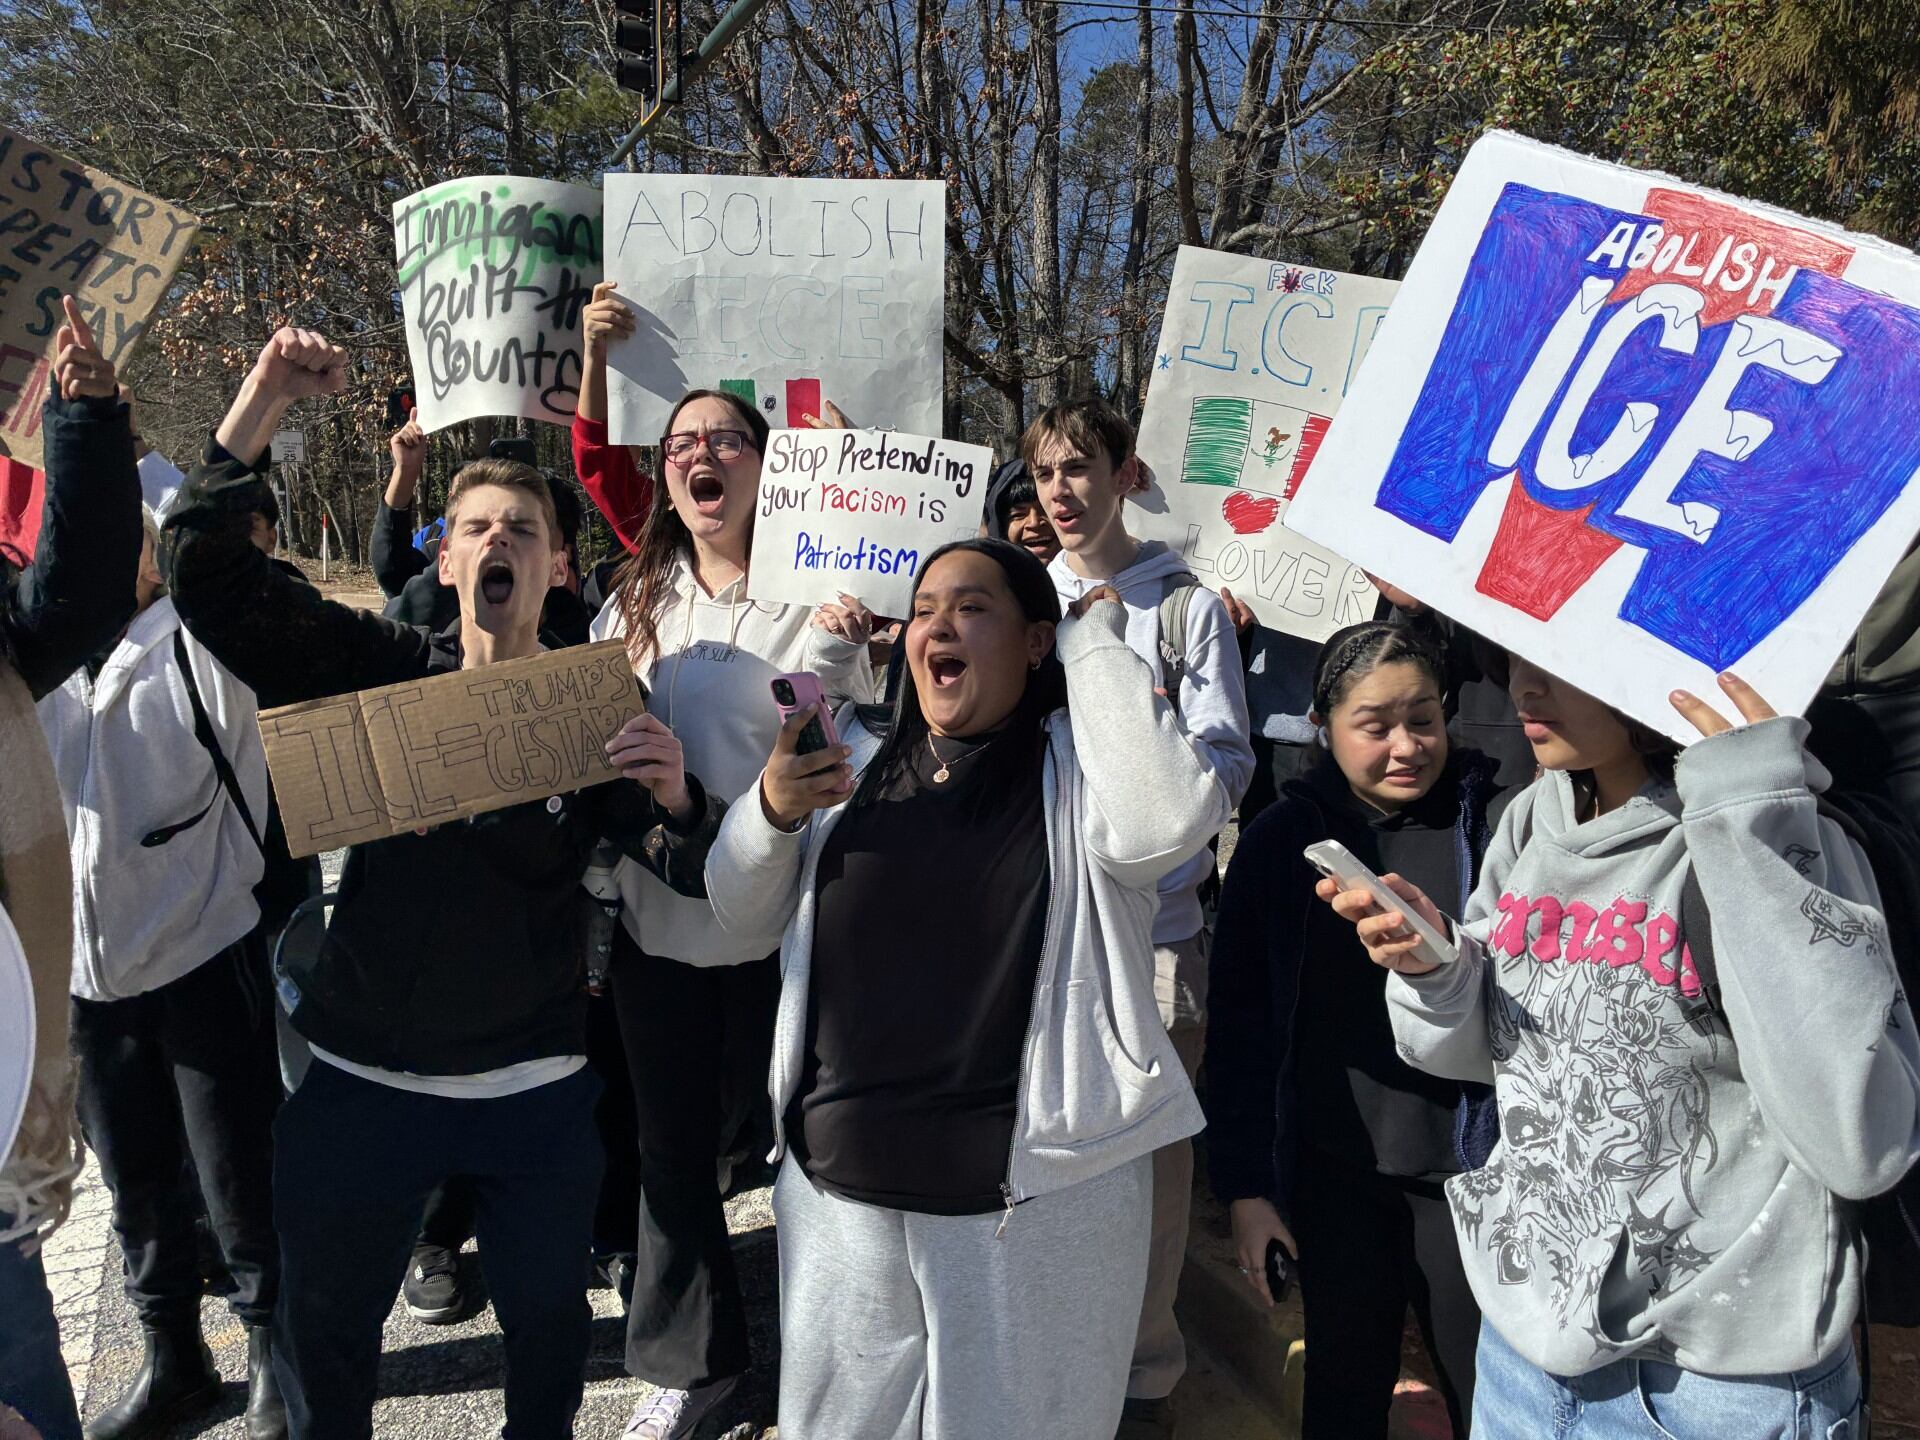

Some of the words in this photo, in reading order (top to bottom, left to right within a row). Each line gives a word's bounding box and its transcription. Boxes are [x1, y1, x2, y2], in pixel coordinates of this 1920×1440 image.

[0, 195, 162, 305] PEATS
[396, 191, 604, 276] Immigran
[617, 190, 925, 261] ABOLISH
[1586, 220, 1797, 310] ABOLISH
[418, 264, 547, 342] built
[535, 267, 594, 331] th
[1487, 278, 1843, 545] ICE
[283, 453, 297, 461] 25
[769, 433, 828, 482] Stop
[837, 433, 973, 498] Pretending
[762, 483, 812, 518] your
[820, 482, 907, 516] racism
[919, 492, 947, 523] is
[794, 531, 919, 577] Patriotism
[1183, 523, 1375, 627] LOVER
[467, 653, 631, 718] TRUMP'S
[276, 687, 458, 840] ICE
[485, 706, 644, 793] GESTAP
